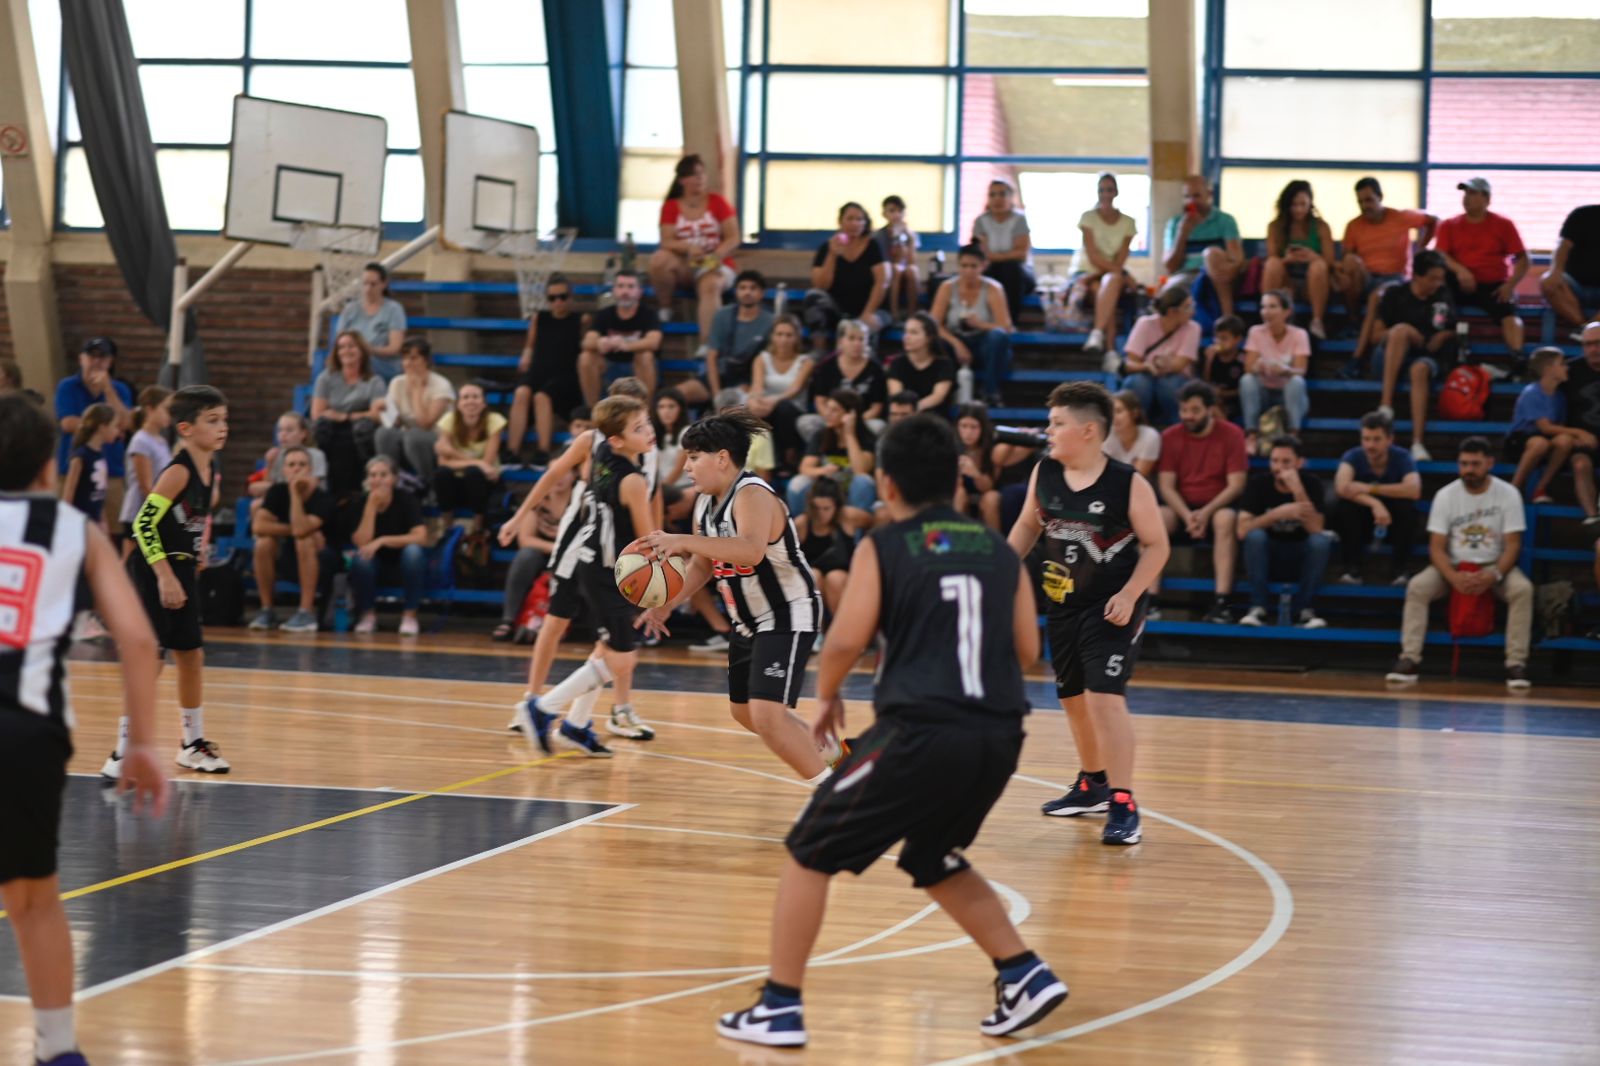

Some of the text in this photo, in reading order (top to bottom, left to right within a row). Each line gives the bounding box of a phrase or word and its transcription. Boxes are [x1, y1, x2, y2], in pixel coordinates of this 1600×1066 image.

[1064, 545, 1079, 564] 5
[940, 574, 984, 698] 1
[1104, 654, 1125, 677] 5
